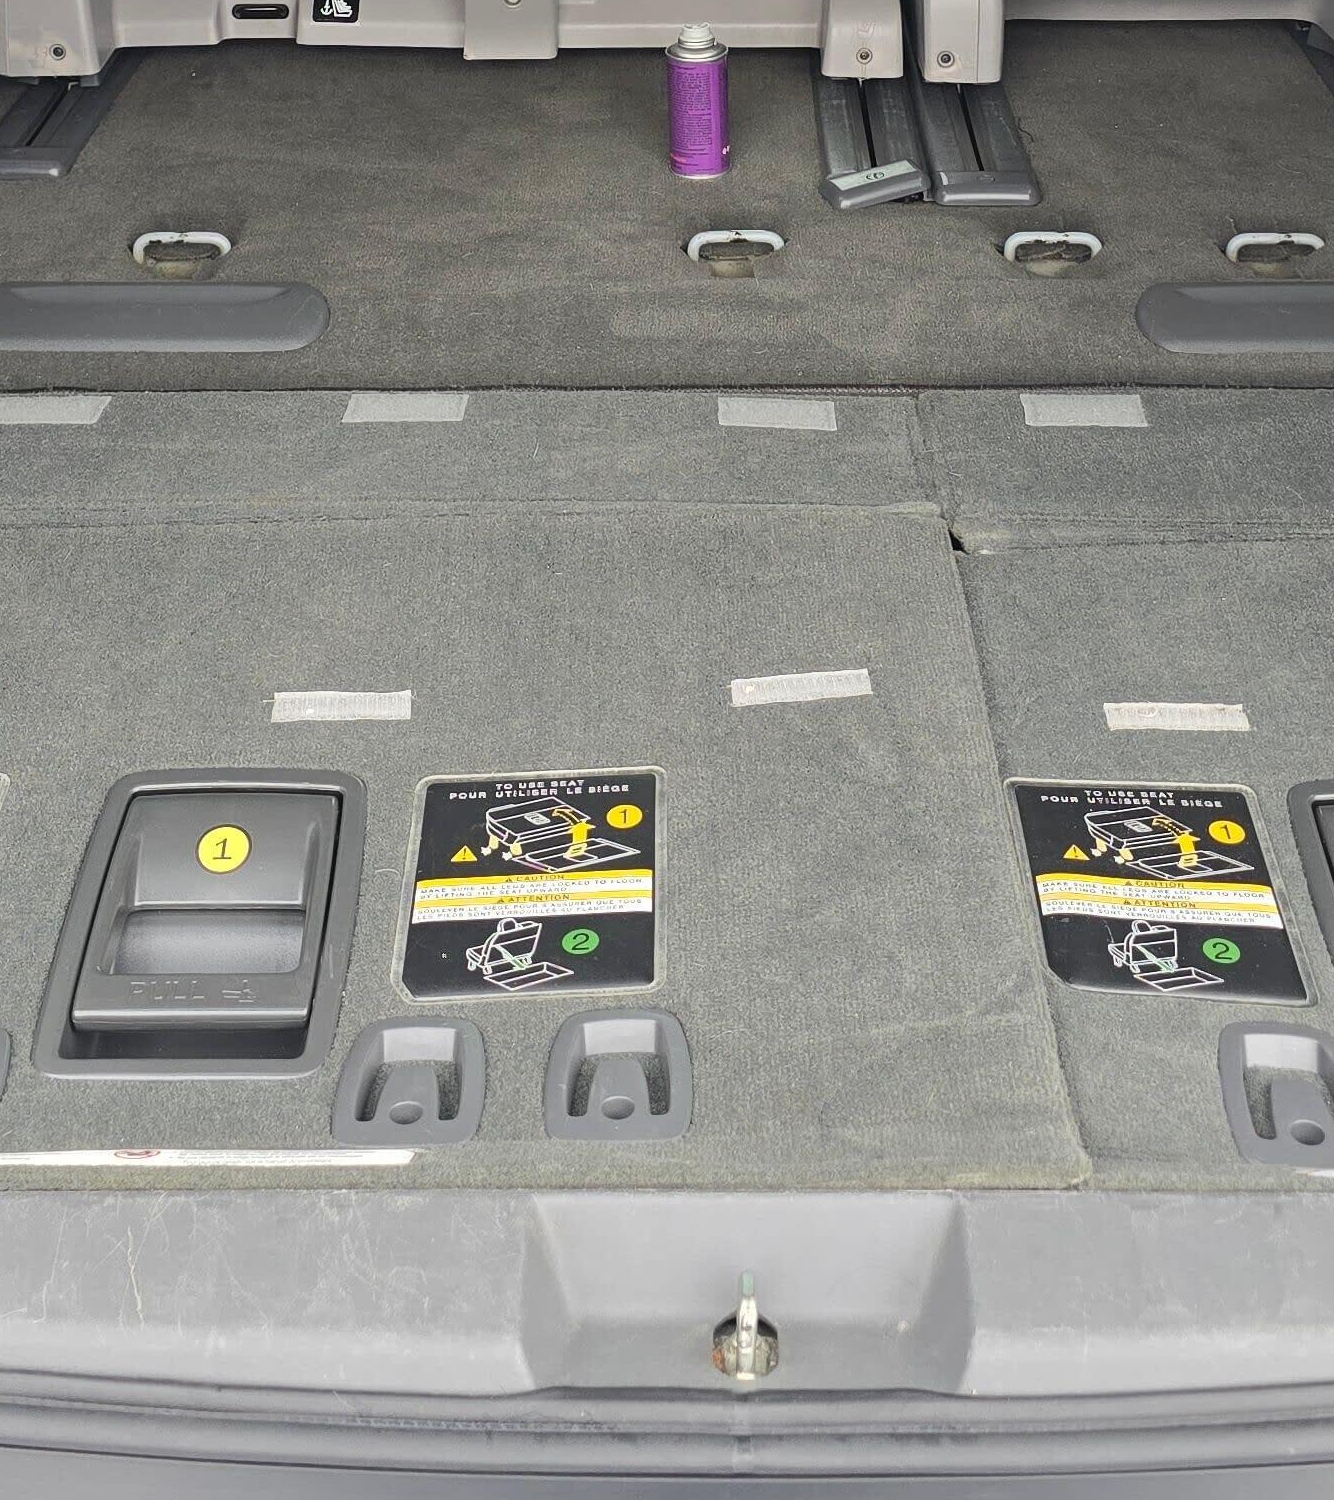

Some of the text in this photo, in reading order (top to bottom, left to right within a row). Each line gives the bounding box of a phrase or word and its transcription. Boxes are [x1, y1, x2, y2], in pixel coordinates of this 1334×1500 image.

[495, 783, 513, 791] TO
[551, 780, 585, 788] SEAT
[449, 791, 487, 800] POUR
[495, 788, 558, 798] UTILISER
[566, 787, 582, 795] LE
[1140, 791, 1174, 799] SEAT
[1041, 795, 1079, 803] POUR
[1087, 797, 1151, 805] UTILISER
[212, 838, 232, 860] 1
[516, 874, 565, 882] CAUTION
[507, 894, 570, 903] ATTENTION
[1134, 900, 1196, 908] ATTENTION
[571, 932, 591, 951] 2
[1212, 942, 1233, 960] 2
[130, 980, 205, 1000] PULL
